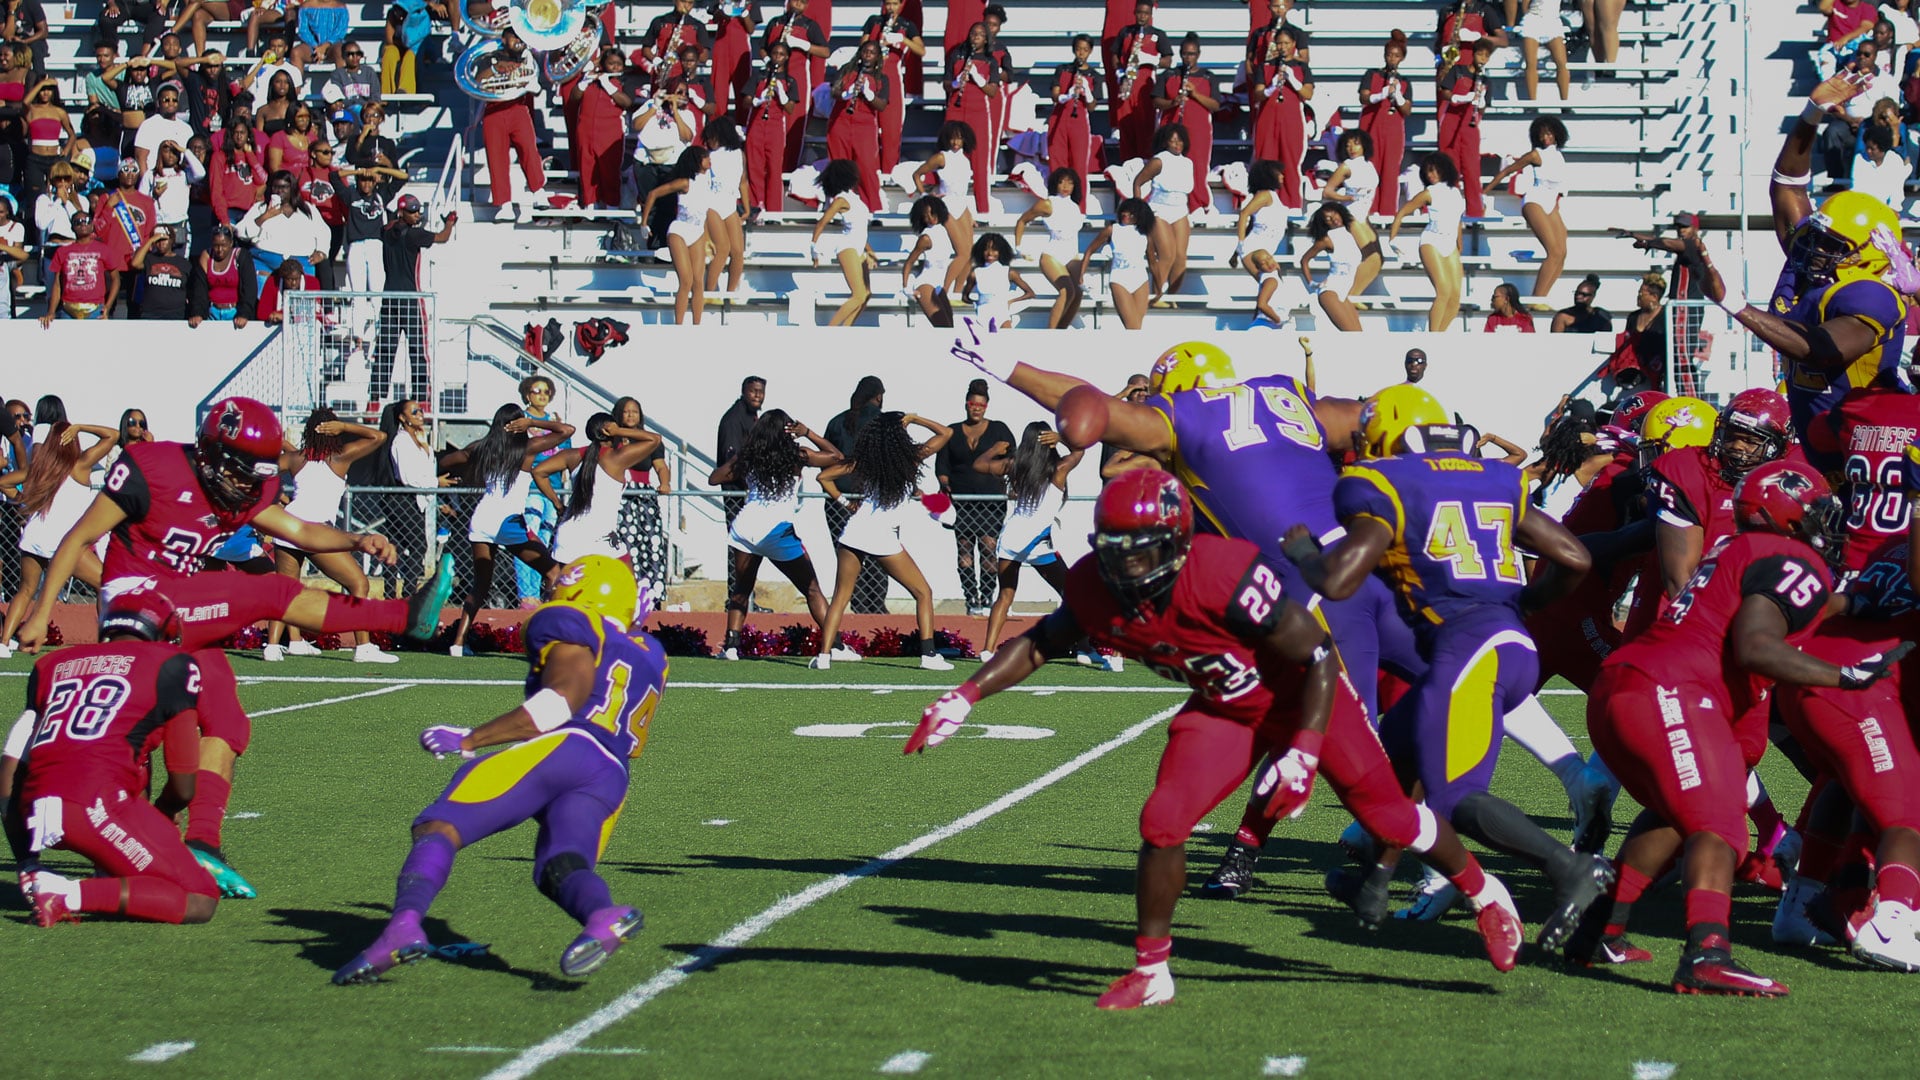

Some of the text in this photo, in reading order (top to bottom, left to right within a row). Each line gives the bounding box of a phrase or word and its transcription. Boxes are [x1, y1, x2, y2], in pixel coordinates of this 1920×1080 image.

[1196, 384, 1323, 451] 79
[1423, 501, 1527, 586] 47
[1239, 564, 1281, 623] 22
[1775, 560, 1822, 607] 75
[53, 655, 136, 682] PANTHERS
[31, 674, 131, 749] 28
[585, 659, 659, 759] 14
[100, 822, 153, 872] ATLANTA
